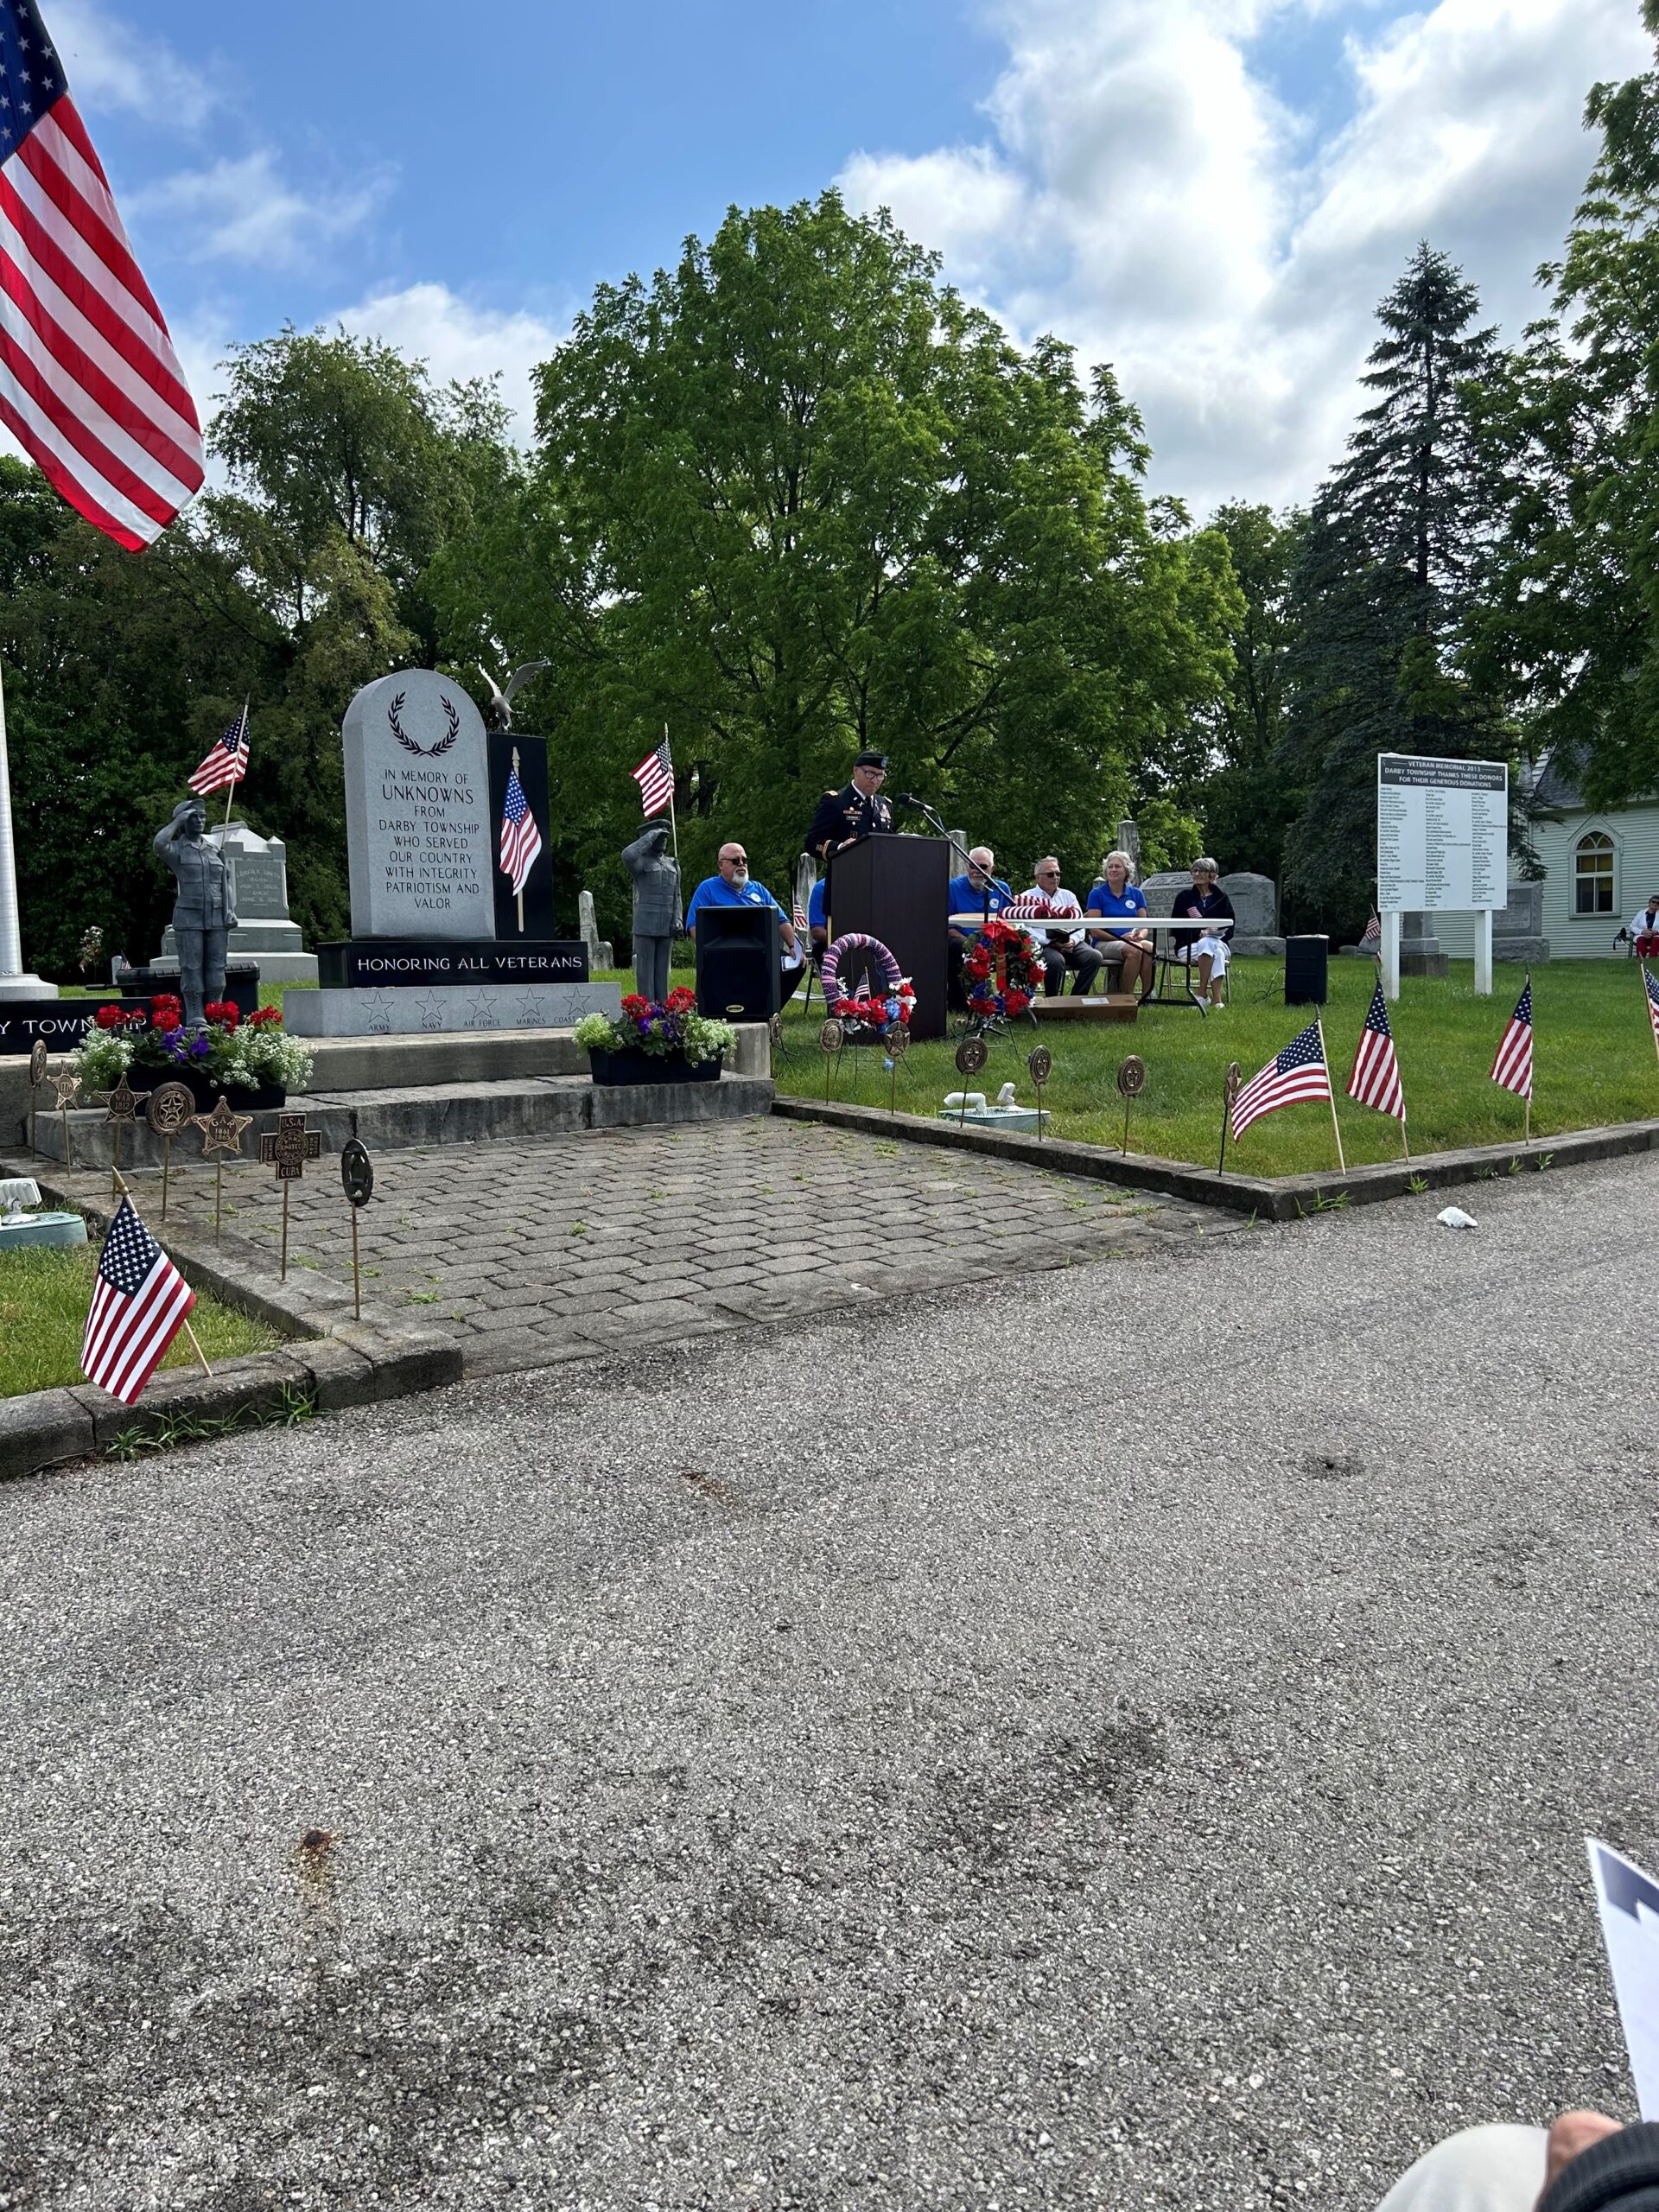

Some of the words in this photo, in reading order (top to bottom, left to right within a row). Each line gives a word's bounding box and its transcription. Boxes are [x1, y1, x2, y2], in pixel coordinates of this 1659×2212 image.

[1408, 760, 1434, 769] VETERAN
[1435, 762, 1465, 771] MEMORIAL
[385, 768, 396, 779] IN
[401, 770, 448, 784] MEMORY
[454, 772, 469, 785] OF
[1406, 768, 1436, 777] TOWNSHIP
[1429, 778, 1459, 786] GENEROUS
[1459, 779, 1491, 788] DONATIONS
[382, 784, 474, 804] UNKNOWNS
[414, 805, 445, 818] FROM
[378, 819, 416, 832] DARBY
[423, 821, 480, 835] TOWNSHIP
[394, 836, 420, 848] WHO
[426, 836, 468, 849] SERVED
[389, 850, 413, 862] OUR
[419, 851, 474, 864] COUNTRY
[385, 866, 414, 878] WITH
[419, 867, 478, 880] INTEGRITY
[386, 881, 451, 894] PATRIOTISM
[456, 883, 480, 894] AND
[415, 897, 451, 909] VALOR
[357, 958, 450, 971] HONORING
[457, 957, 490, 969] ALL
[495, 957, 582, 969] VETERANS
[479, 1019, 501, 1027] FORCE
[115, 1093, 130, 1103] WAR
[115, 1102, 130, 1110] 1812
[282, 1117, 304, 1128] U.S.A.
[281, 1166, 300, 1177] CUBA
